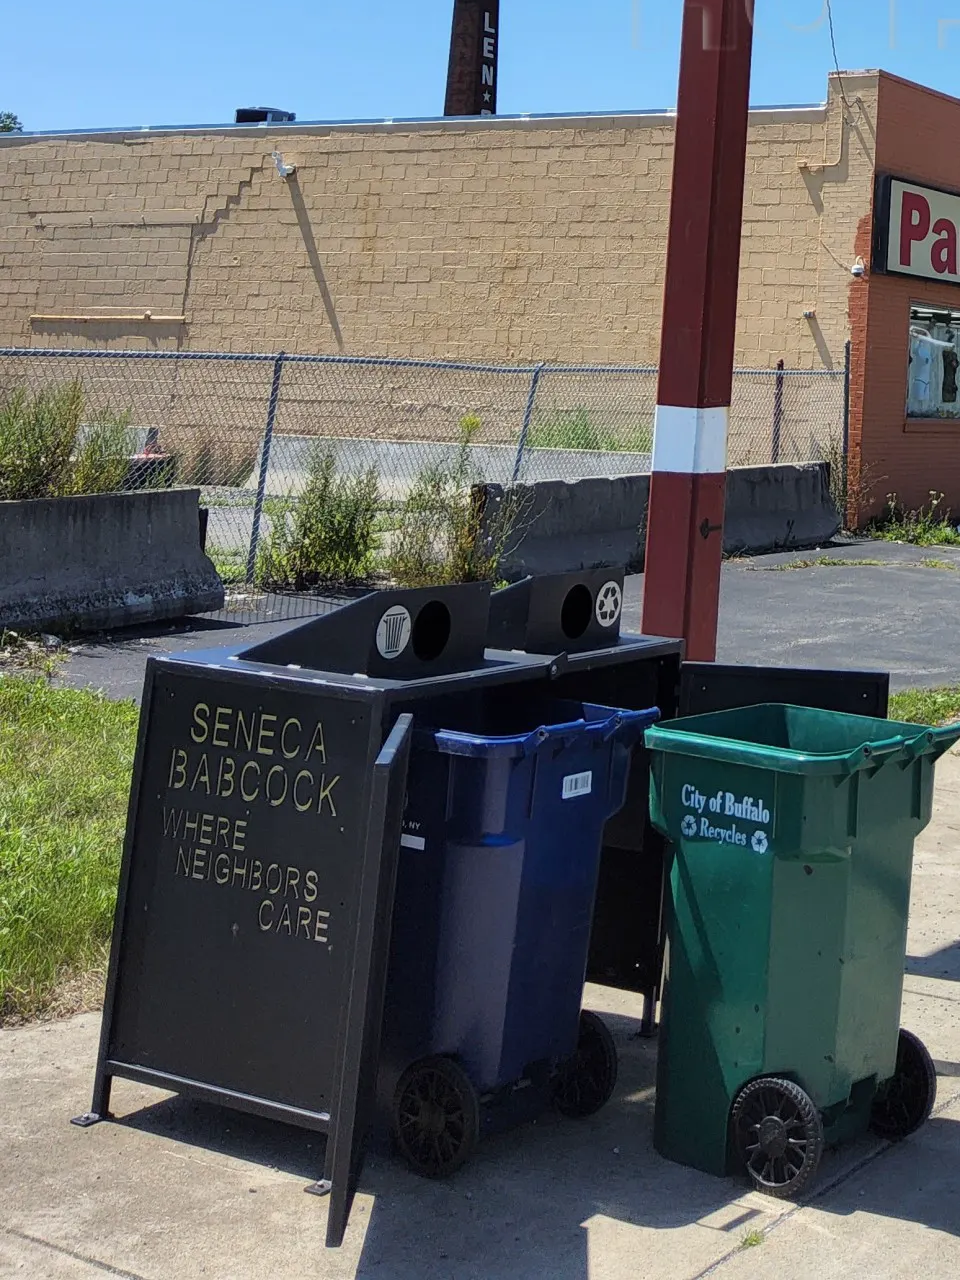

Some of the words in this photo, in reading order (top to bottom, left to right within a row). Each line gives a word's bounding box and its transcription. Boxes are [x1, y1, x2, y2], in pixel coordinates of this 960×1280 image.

[190, 702, 327, 764] SENECA
[168, 748, 340, 817] BABCOCK
[681, 783, 706, 813] City
[709, 790, 724, 813] of
[724, 792, 770, 824] Buffalo
[163, 806, 247, 851] WHERE
[699, 817, 747, 847] Recycles
[175, 845, 318, 902] NEIGHBORS
[258, 899, 330, 943] CARE
